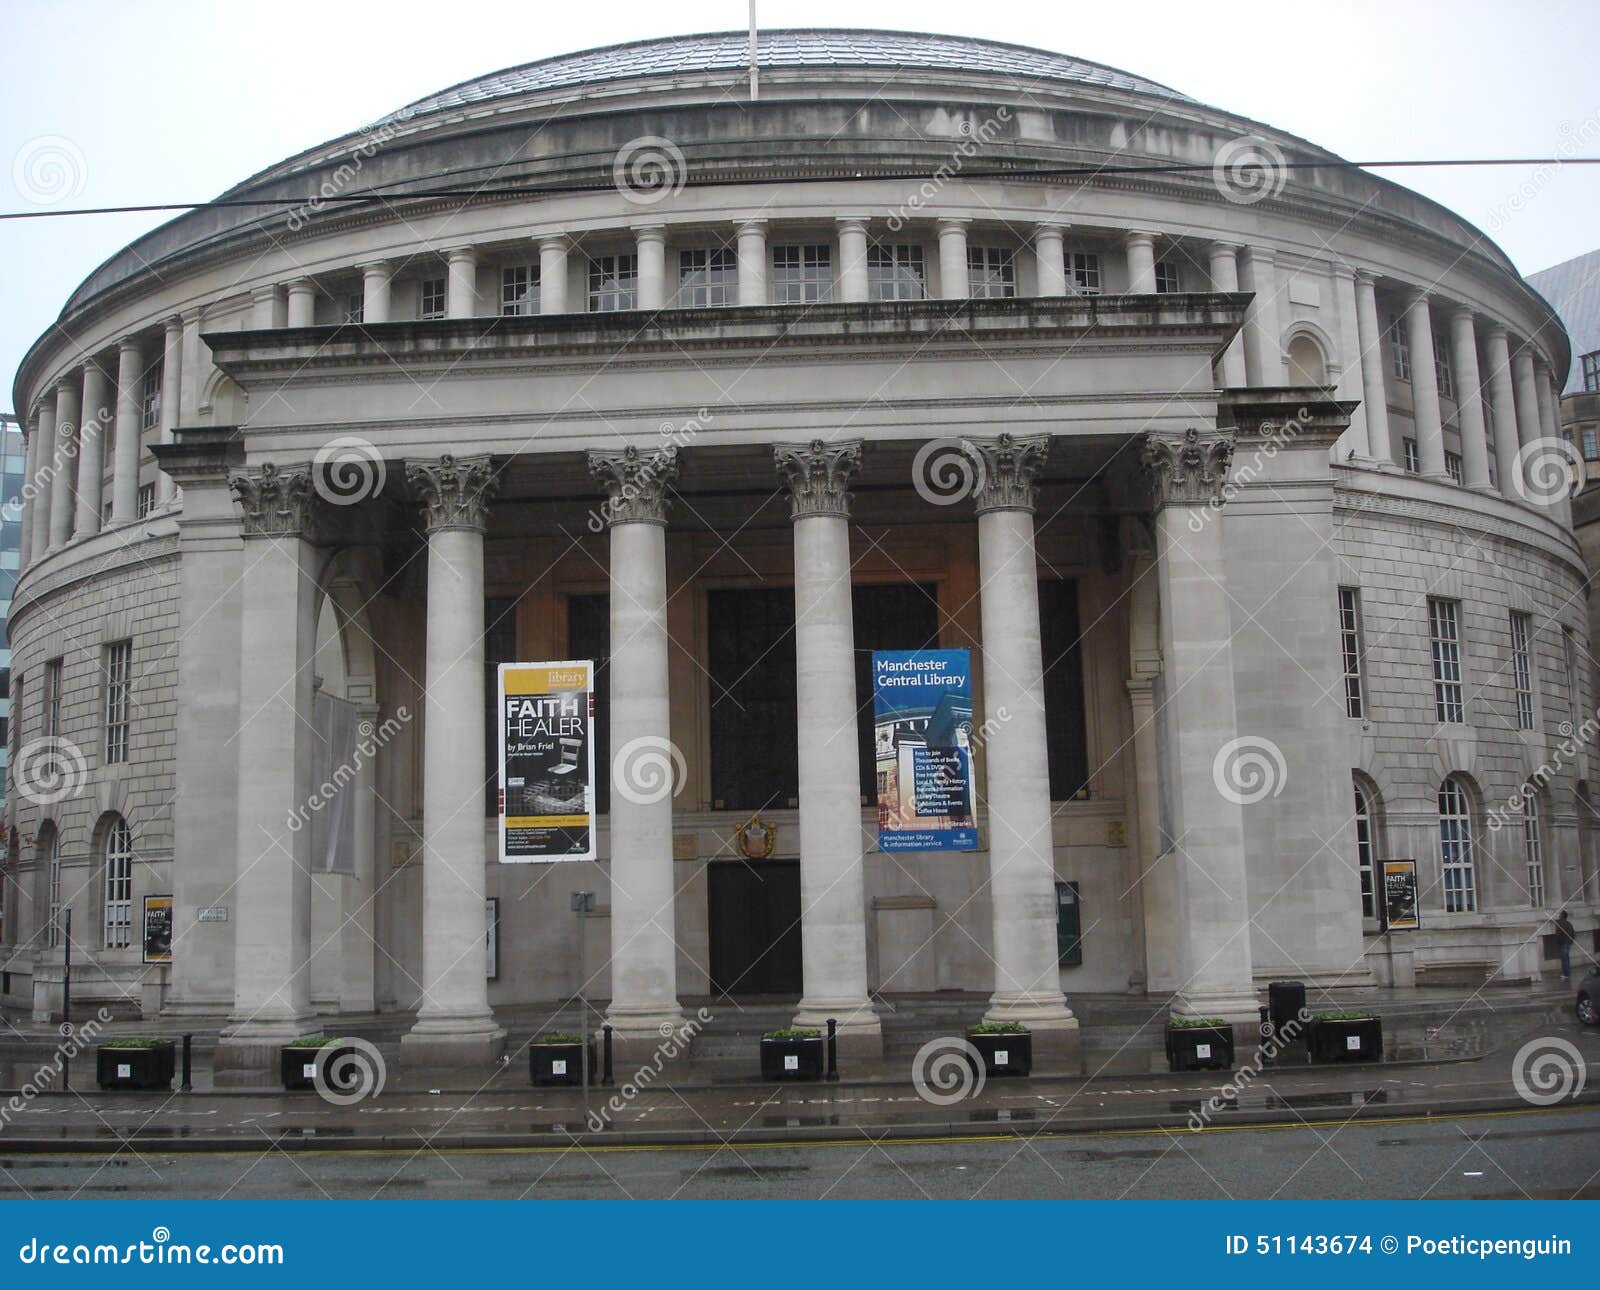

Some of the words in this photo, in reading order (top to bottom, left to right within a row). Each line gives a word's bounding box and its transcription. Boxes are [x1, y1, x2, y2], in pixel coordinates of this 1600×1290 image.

[877, 659, 948, 672] Manchester
[548, 671, 585, 682] library
[878, 674, 922, 687] Central
[924, 673, 965, 688] Library
[506, 698, 579, 718] FAITH
[507, 717, 585, 737] HEALER
[507, 743, 516, 753] by
[517, 742, 537, 751] Brian
[538, 742, 554, 750] Friel
[916, 833, 935, 842] library
